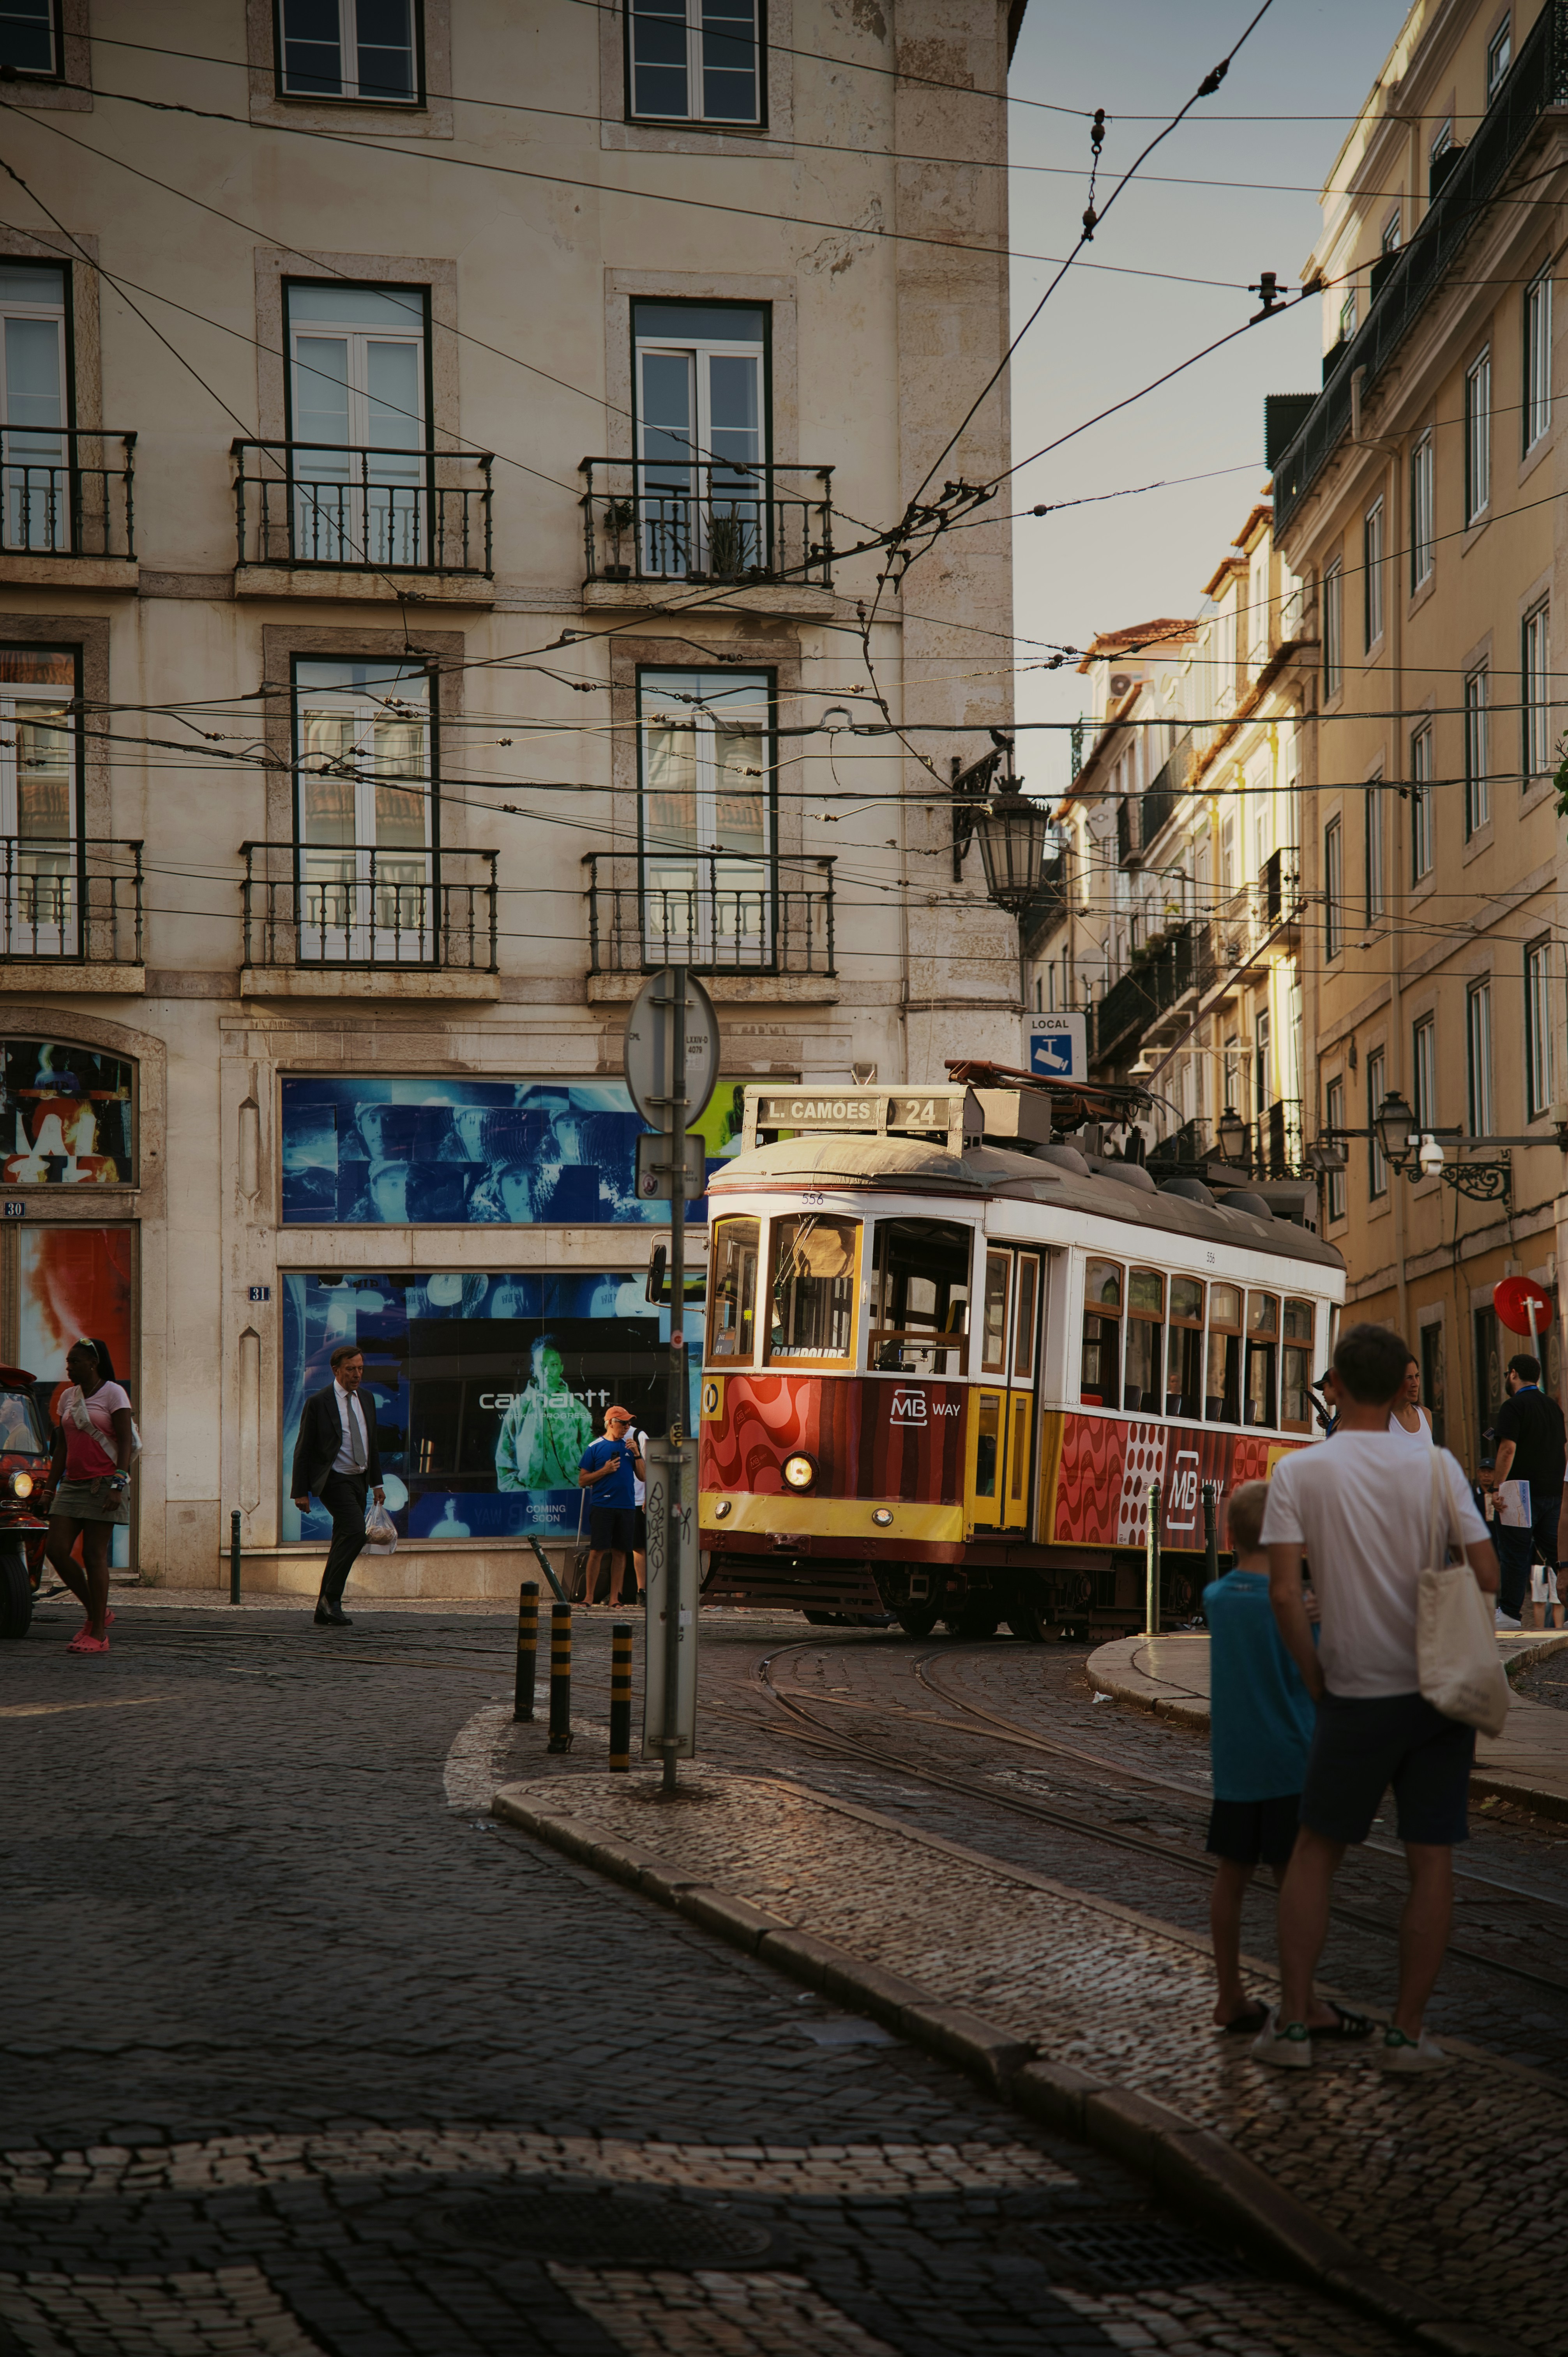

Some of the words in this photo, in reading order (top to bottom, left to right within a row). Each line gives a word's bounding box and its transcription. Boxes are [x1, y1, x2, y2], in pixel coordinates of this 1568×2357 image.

[1032, 1019, 1069, 1028] LOCAL
[770, 1101, 784, 1118] L.
[905, 1100, 936, 1125] 24
[802, 1193, 823, 1205] 556
[7, 1203, 22, 1216] 30
[1207, 1252, 1215, 1263] 556
[253, 1288, 265, 1300] 31
[715, 1345, 722, 1353] 01
[479, 1389, 610, 1409] carhartt
[890, 1398, 927, 1417] MB
[932, 1403, 961, 1416] WAY
[1169, 1470, 1197, 1510] MB
[526, 1505, 566, 1513] COMING
[532, 1514, 560, 1522] SOON
